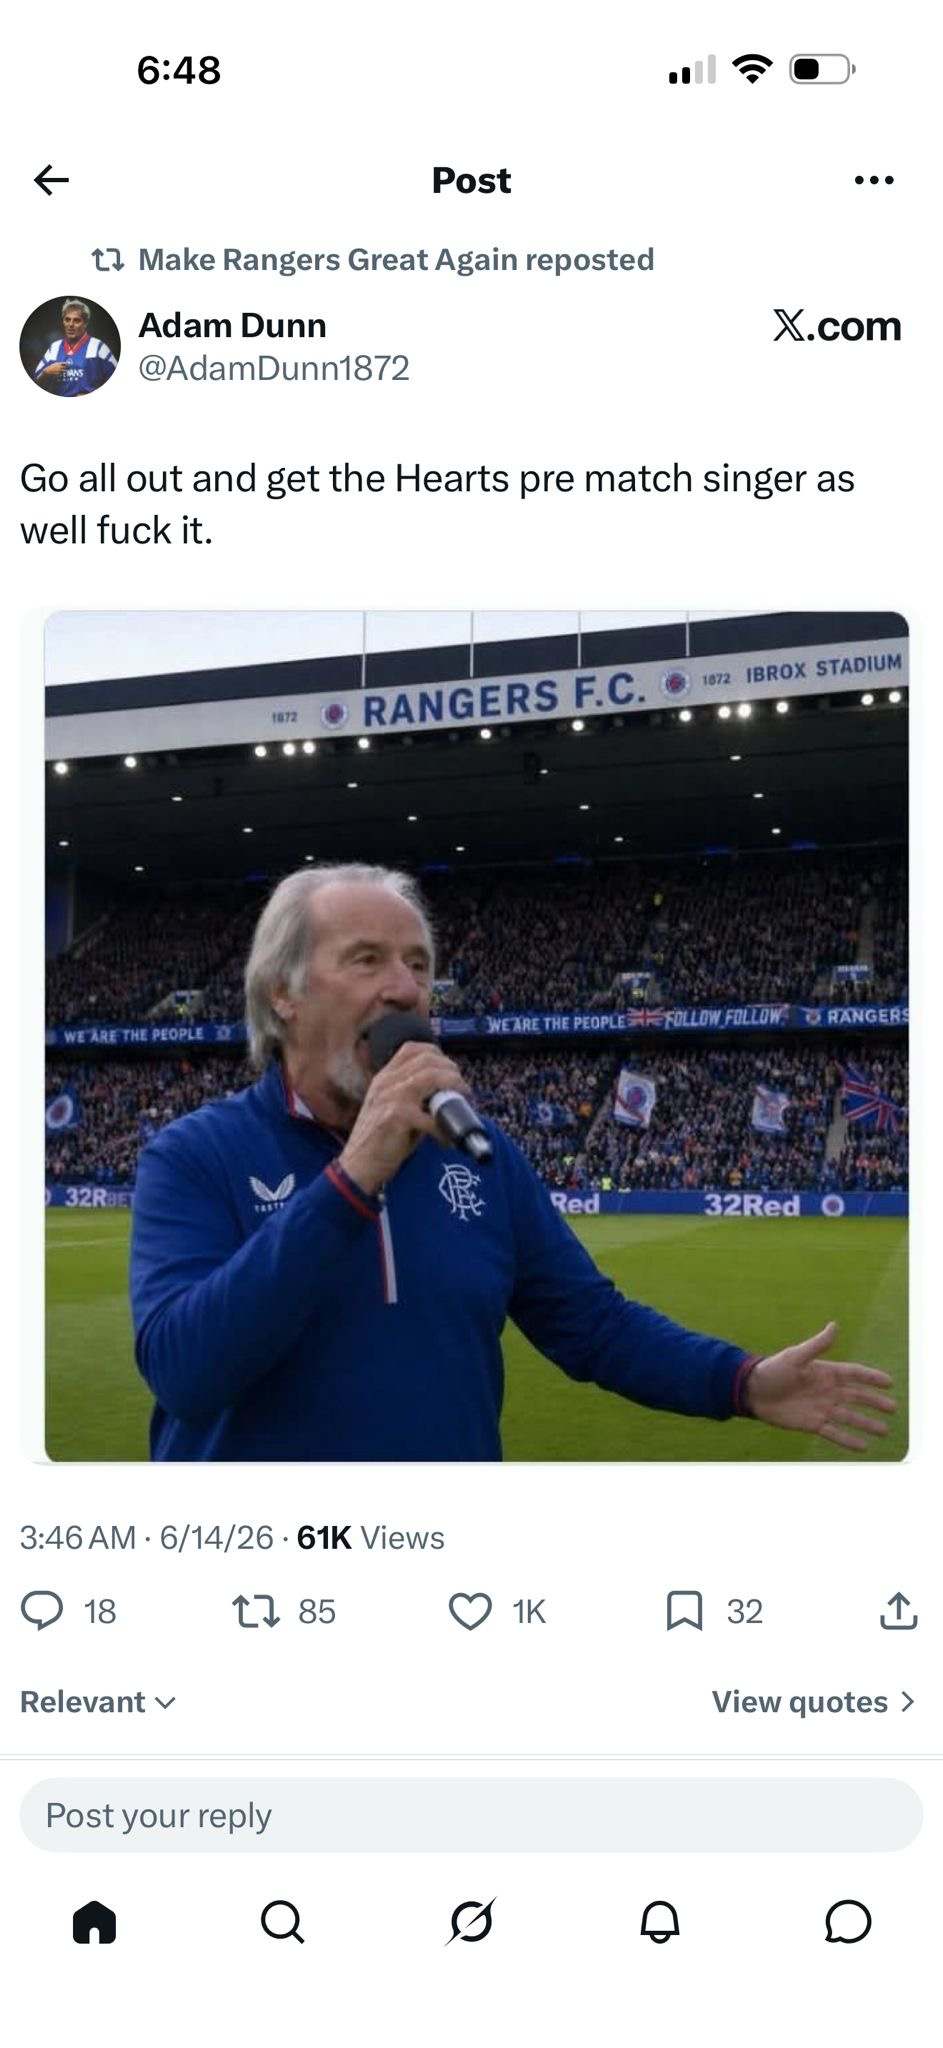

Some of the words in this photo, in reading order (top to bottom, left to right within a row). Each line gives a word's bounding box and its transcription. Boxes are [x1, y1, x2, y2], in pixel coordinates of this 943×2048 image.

[137, 55, 221, 86] 6:48
[432, 166, 512, 195] Post
[139, 246, 216, 272] Make
[224, 247, 341, 277] Rangers
[347, 247, 429, 272] Great
[434, 246, 518, 277] Again
[526, 246, 655, 277] reposted
[138, 310, 232, 339] Adam
[241, 311, 327, 339] Dunn
[138, 353, 410, 383] @AdamDunn1872
[20, 462, 69, 494] Go
[79, 461, 116, 493] all
[126, 464, 183, 493] out
[192, 461, 256, 493] and
[265, 464, 321, 501] get
[328, 461, 386, 493] the
[396, 463, 510, 493] Hearts
[520, 470, 575, 500] pre
[585, 461, 693, 493] match
[703, 462, 808, 501] singer
[816, 470, 855, 493] as
[19, 513, 86, 545] well
[96, 513, 173, 545] fuck
[182, 514, 212, 545] it.
[702, 672, 732, 686] 1872
[746, 662, 806, 683] IBROX
[816, 653, 903, 677] STADIUM
[363, 677, 559, 728] RANGERS
[573, 672, 646, 708] F.C.
[487, 1016, 509, 1033] WE
[512, 1017, 540, 1032] ARE
[543, 1016, 570, 1030] THE
[573, 1015, 626, 1030] PEOPLE
[664, 1010, 721, 1029] FOLLOW
[724, 1008, 783, 1027] FOLLOW
[64, 1030, 85, 1043] WE
[90, 1029, 117, 1043] ARE
[123, 1028, 148, 1041] THE
[152, 1027, 204, 1041] PEOPLE
[704, 1193, 801, 1216] 32Red
[20, 1524, 83, 1550] 3:46
[87, 1525, 136, 1550] AM
[160, 1523, 274, 1554] 6/14/26
[296, 1524, 353, 1551] 61K
[359, 1524, 445, 1551] Views
[84, 1598, 117, 1625] 18
[298, 1598, 336, 1625] 85
[512, 1598, 547, 1624] 1K
[727, 1598, 763, 1625] 32
[20, 1688, 146, 1714] Relevant
[711, 1688, 783, 1714] View
[789, 1691, 889, 1720] quotes
[47, 1802, 115, 1829] Post
[121, 1808, 191, 1836] your
[199, 1800, 273, 1836] reply
